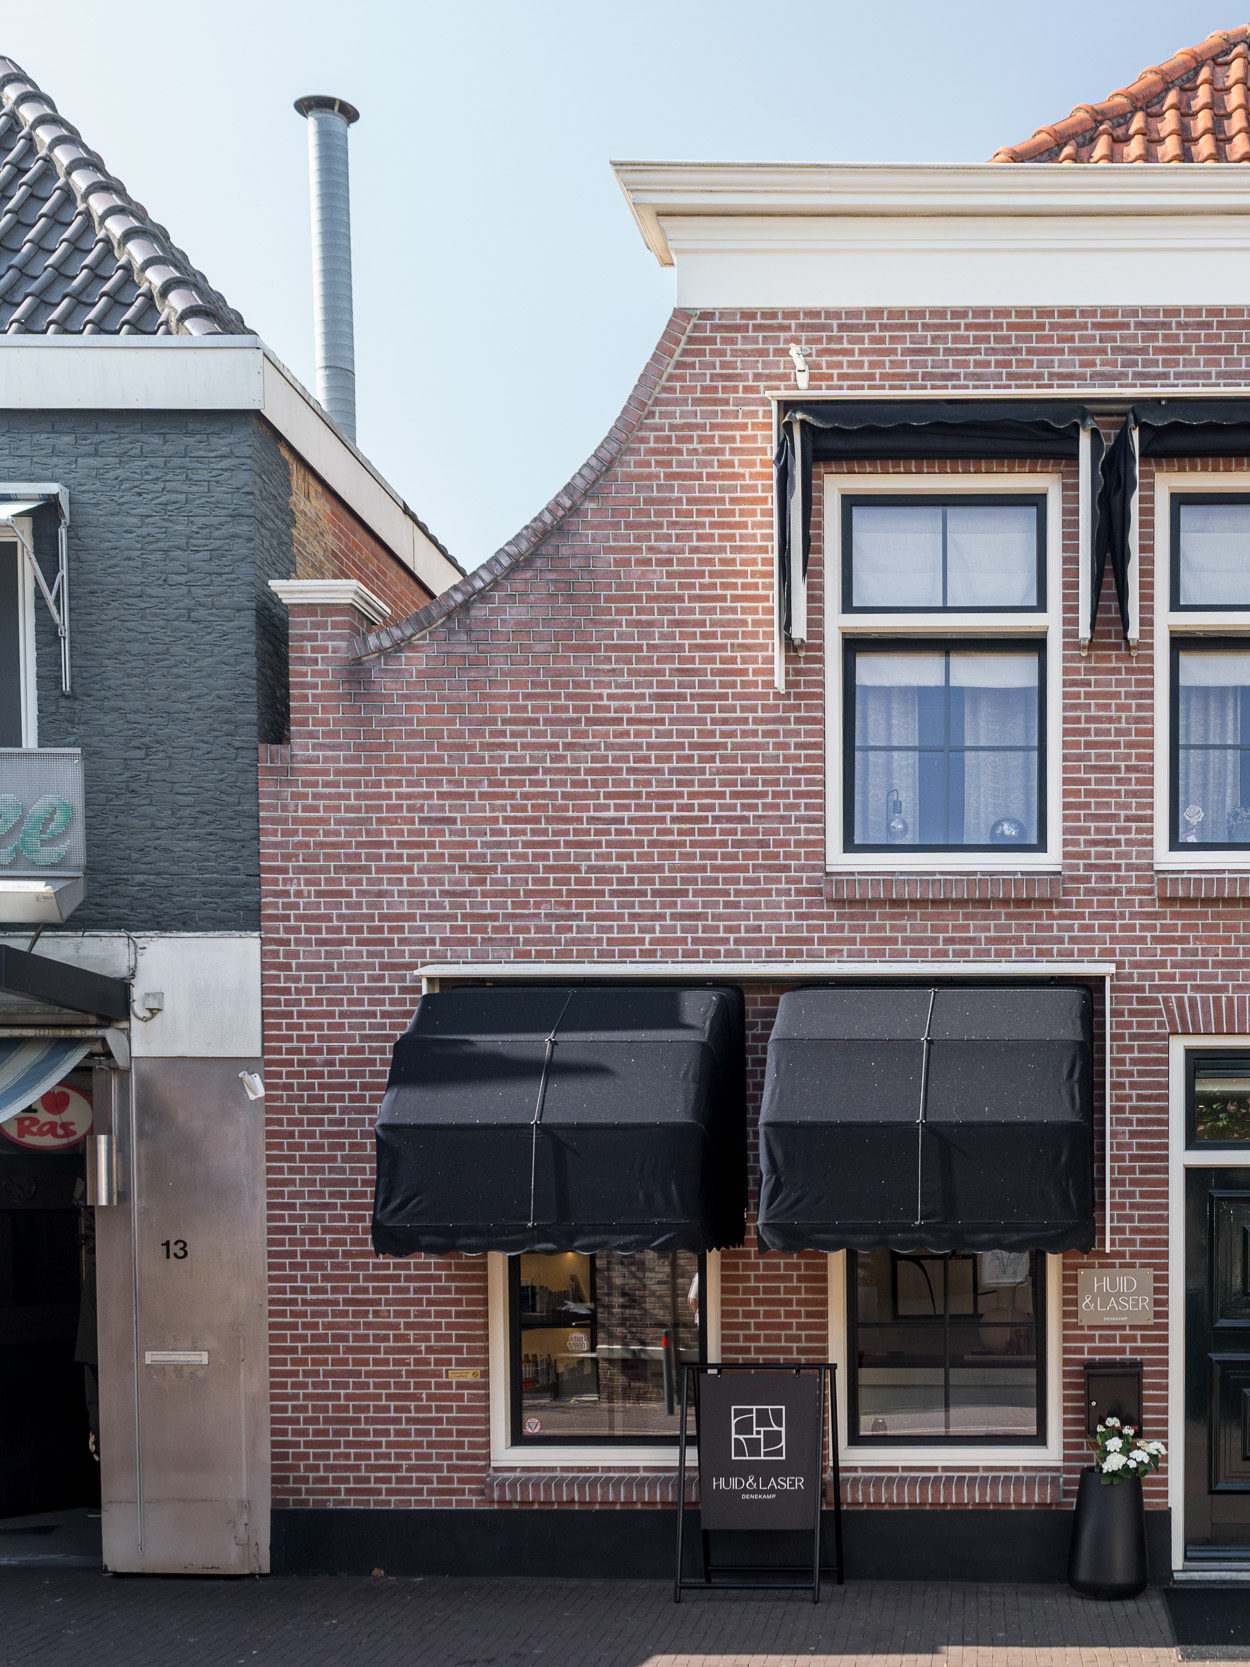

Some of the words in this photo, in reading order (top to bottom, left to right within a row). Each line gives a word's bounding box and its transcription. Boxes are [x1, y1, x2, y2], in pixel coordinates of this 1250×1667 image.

[14, 1116, 78, 1139] Ras
[161, 1239, 189, 1260] 13
[1094, 1276, 1137, 1293] HUID
